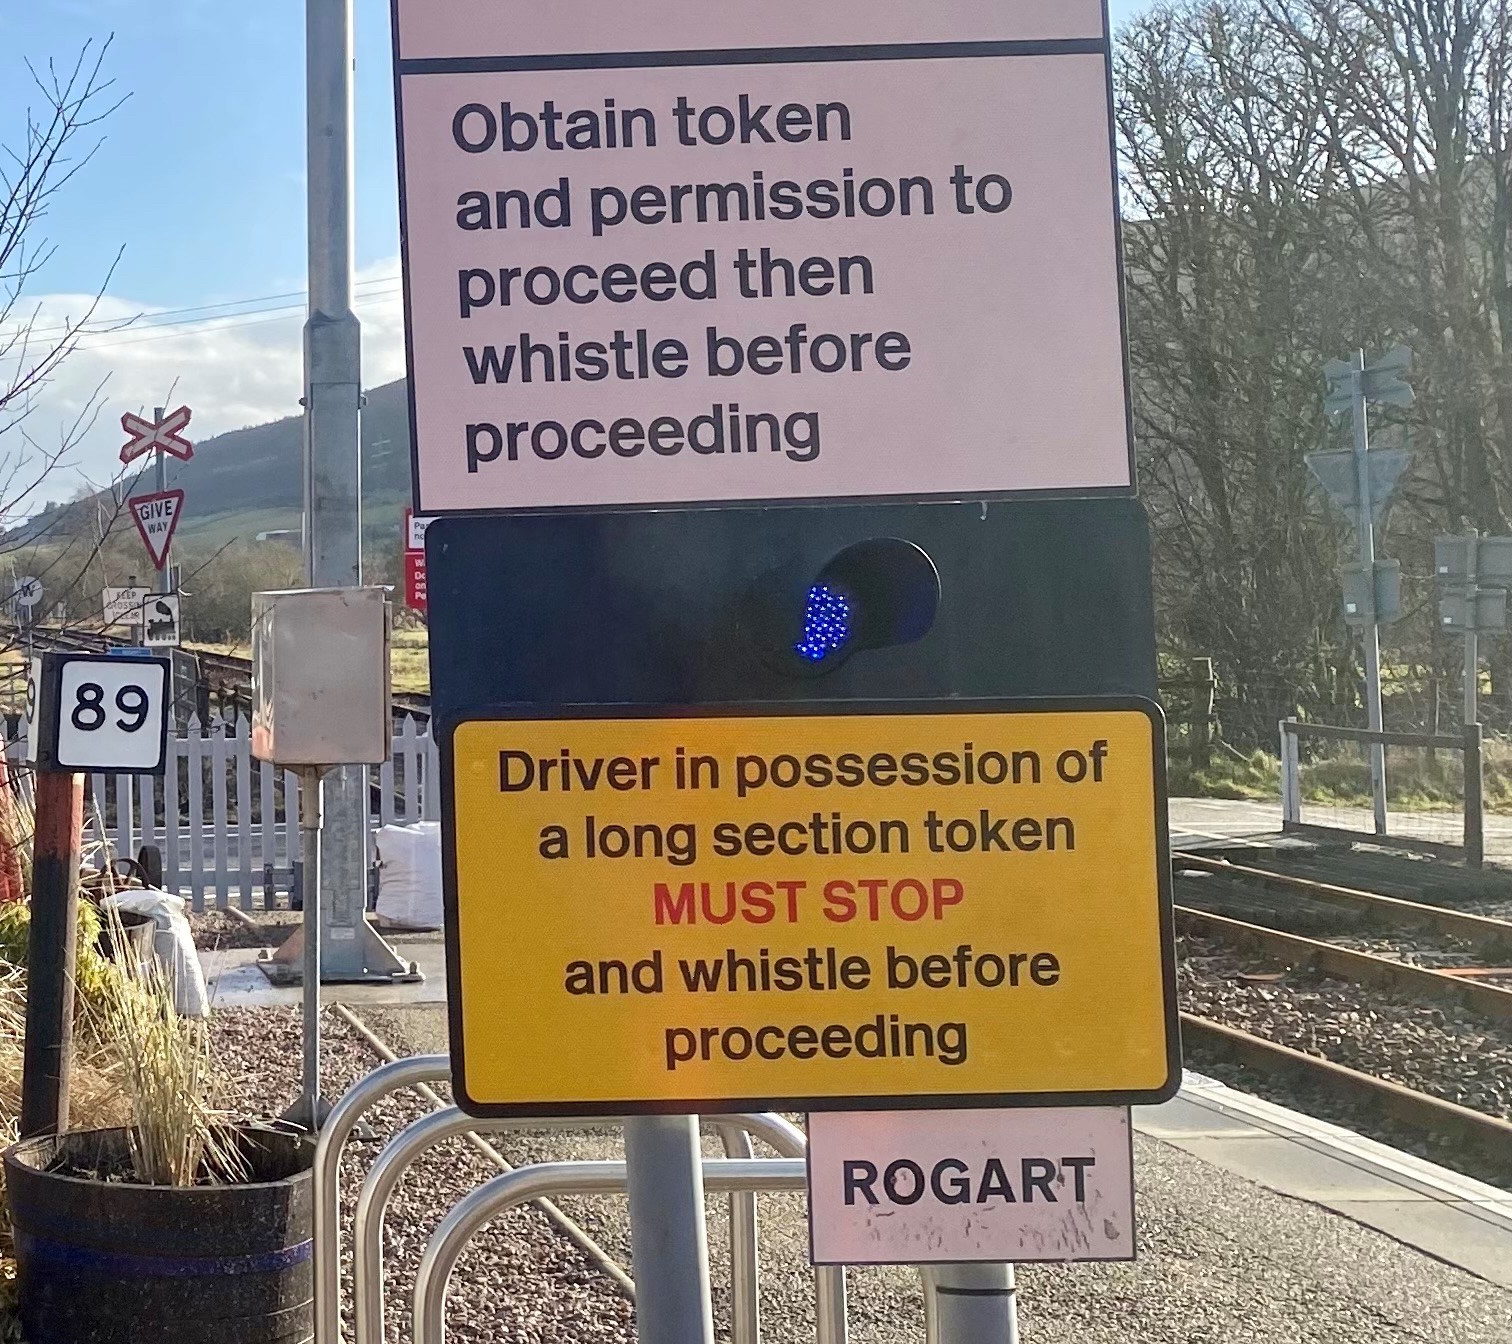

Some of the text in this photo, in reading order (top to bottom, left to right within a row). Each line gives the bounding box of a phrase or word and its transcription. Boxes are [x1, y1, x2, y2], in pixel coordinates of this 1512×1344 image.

[452, 94, 850, 153] Obtain token
[457, 165, 1012, 236] and permission to
[459, 248, 873, 318] proceed then
[463, 324, 910, 384] whistle before
[466, 403, 820, 473] proceeding
[140, 500, 173, 521] GIVE
[148, 522, 168, 534] WAY
[72, 683, 148, 732] 89
[499, 740, 1107, 797] Driver in possession of
[539, 810, 1074, 866] a long section token
[654, 879, 963, 925] MUST STOP
[565, 945, 1060, 995] and whistle before
[666, 1015, 967, 1070] proceeding
[844, 1157, 1095, 1205] ROGART
